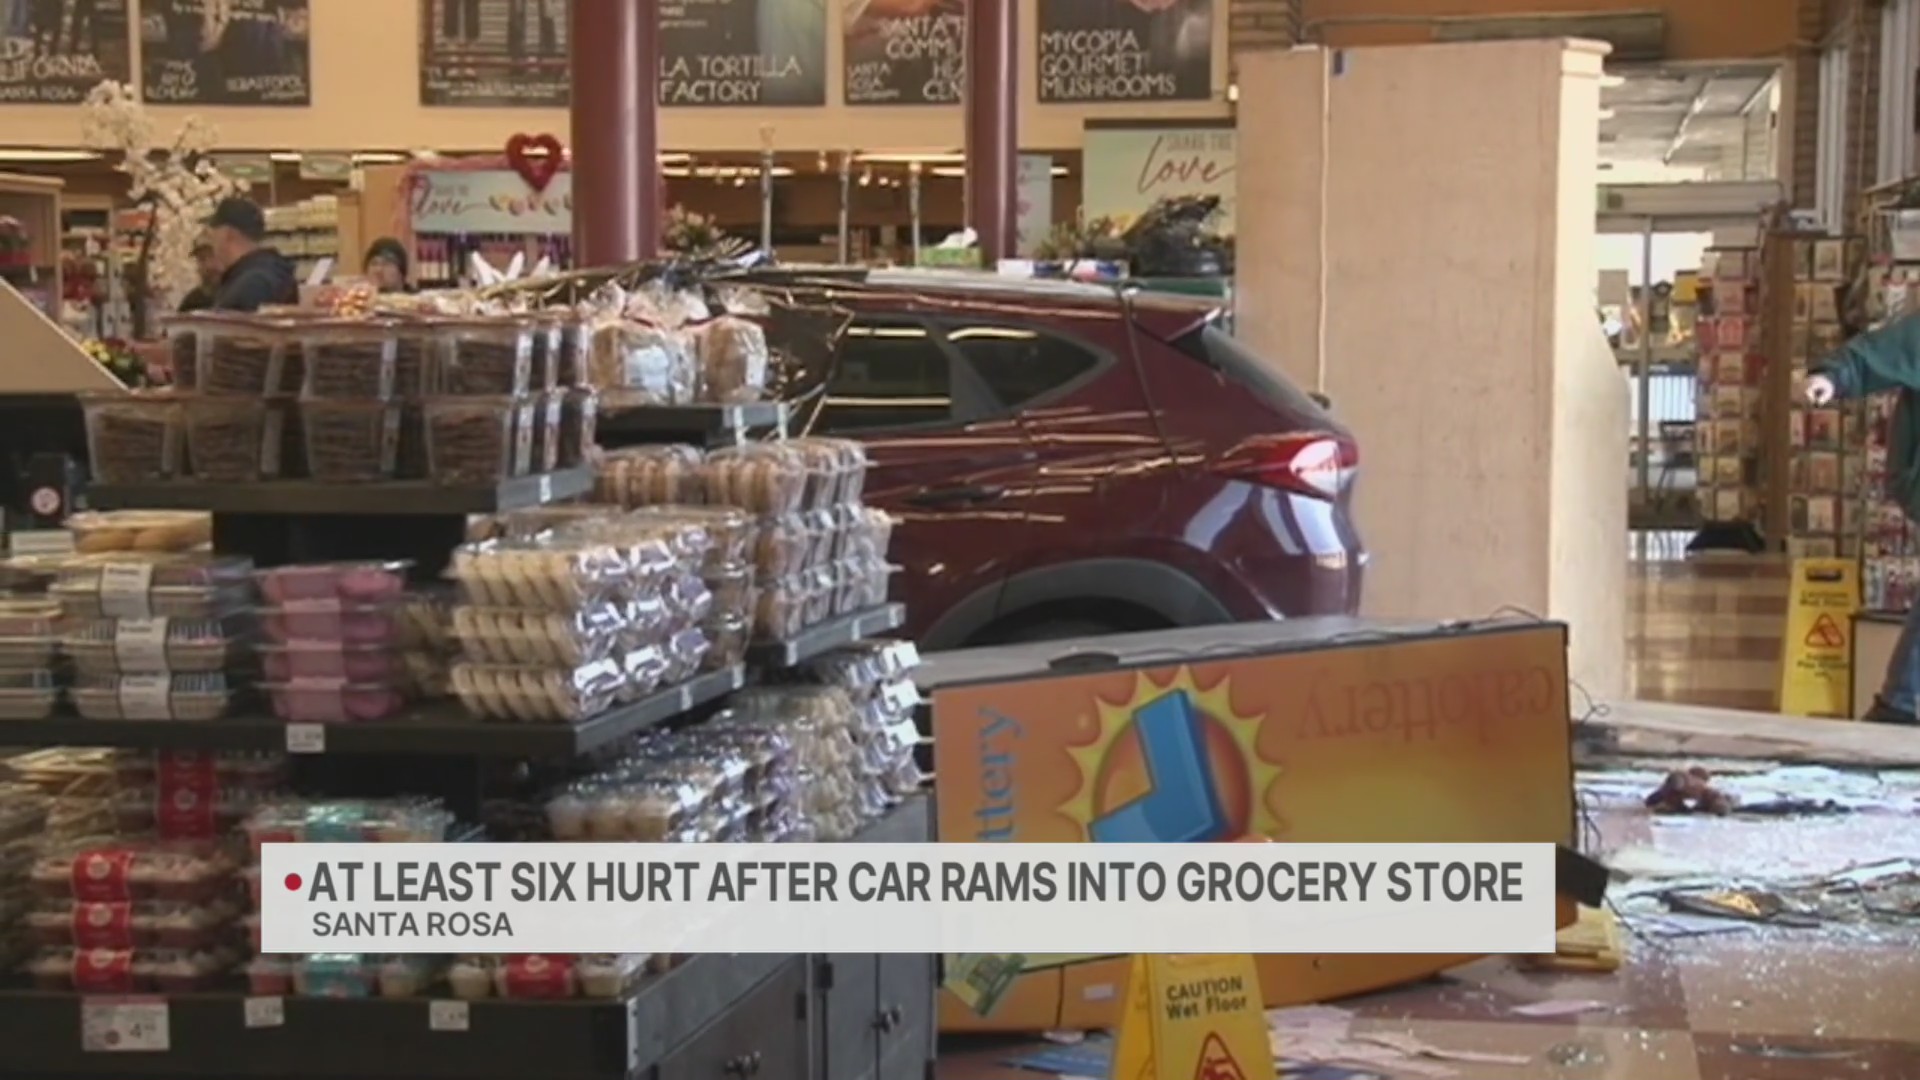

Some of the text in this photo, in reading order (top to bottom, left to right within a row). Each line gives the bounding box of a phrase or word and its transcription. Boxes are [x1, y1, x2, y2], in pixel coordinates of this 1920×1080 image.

[1041, 29, 1139, 53] MYCOPIA
[659, 55, 802, 78] LA TORTILLA
[1041, 52, 1142, 76] GOURMET
[659, 79, 761, 102] FACTORY
[1041, 73, 1177, 98] MUSHROOMS
[1166, 976, 1243, 1002] CAUTION
[1166, 995, 1247, 1020] Wet Floor
